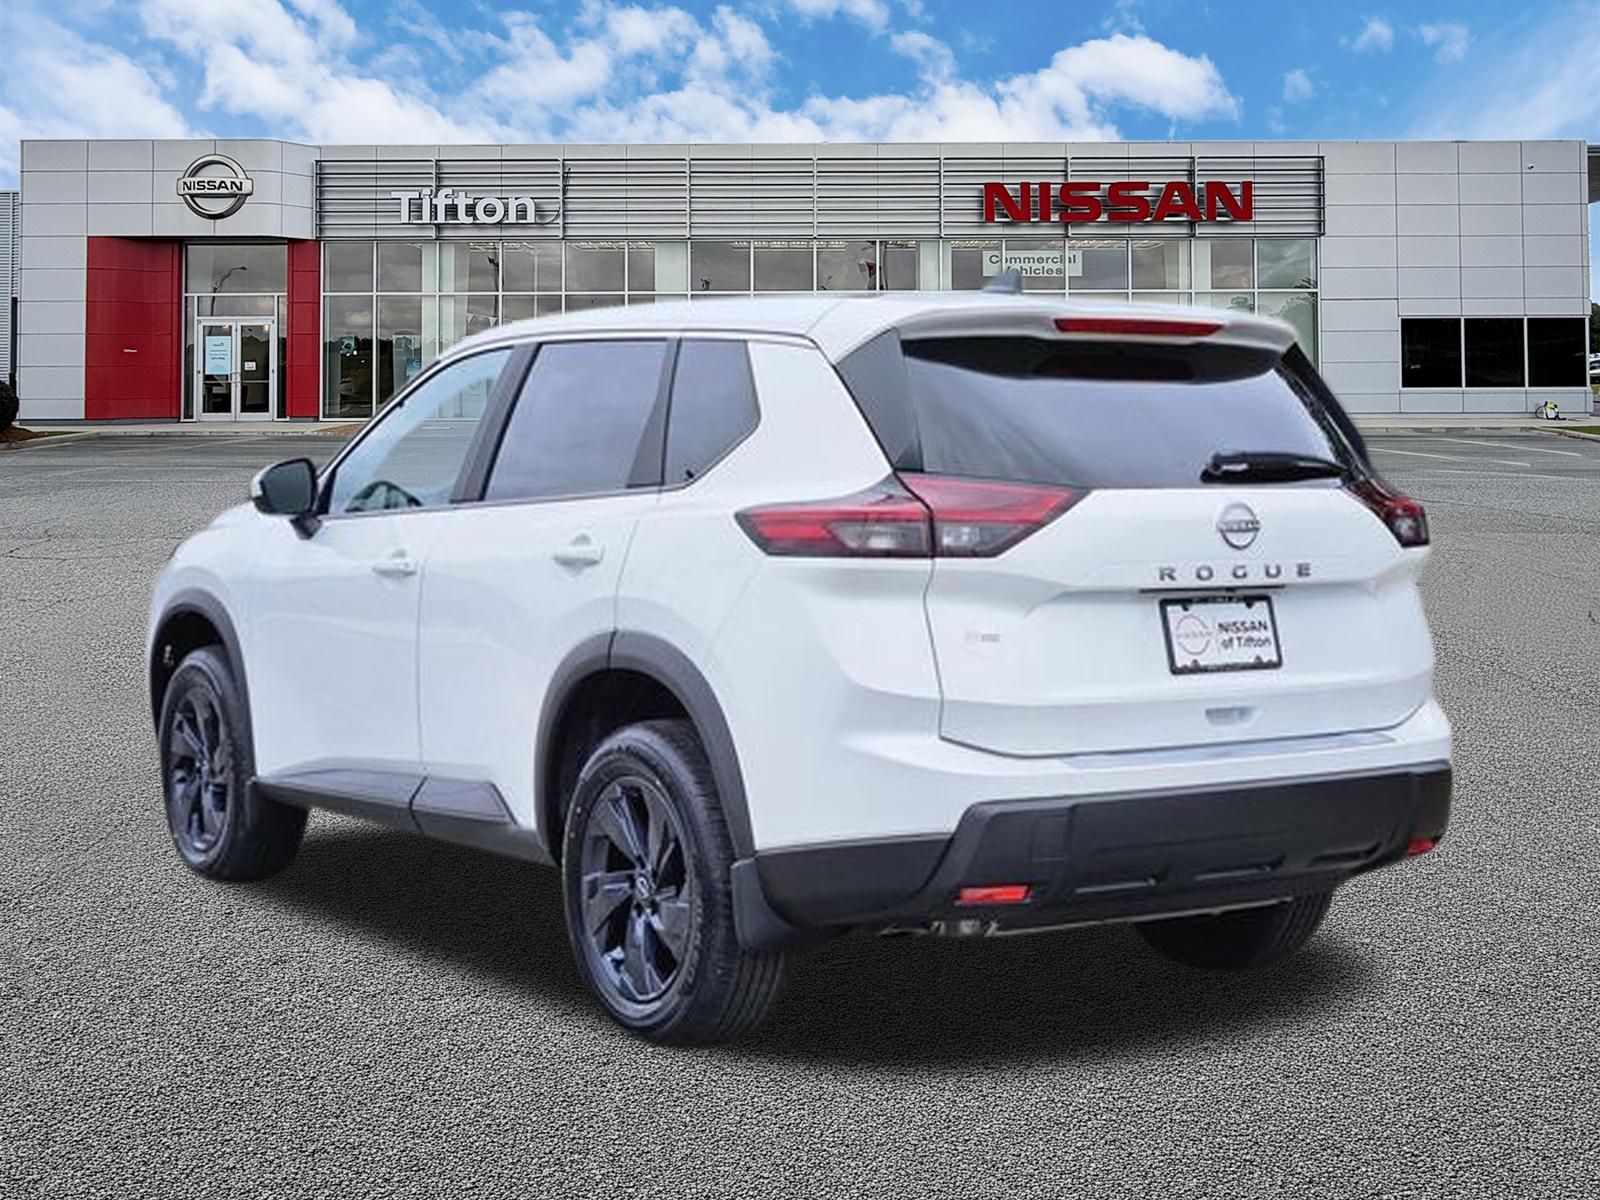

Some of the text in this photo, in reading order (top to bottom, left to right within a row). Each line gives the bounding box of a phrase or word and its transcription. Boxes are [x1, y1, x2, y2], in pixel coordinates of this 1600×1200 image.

[182, 180, 243, 191] NISSAN
[391, 188, 535, 223] Tifton
[984, 181, 1253, 222] NISSAN
[1159, 563, 1311, 581] ROGUE
[1217, 620, 1268, 633] NISSAN
[1220, 636, 1235, 651] of
